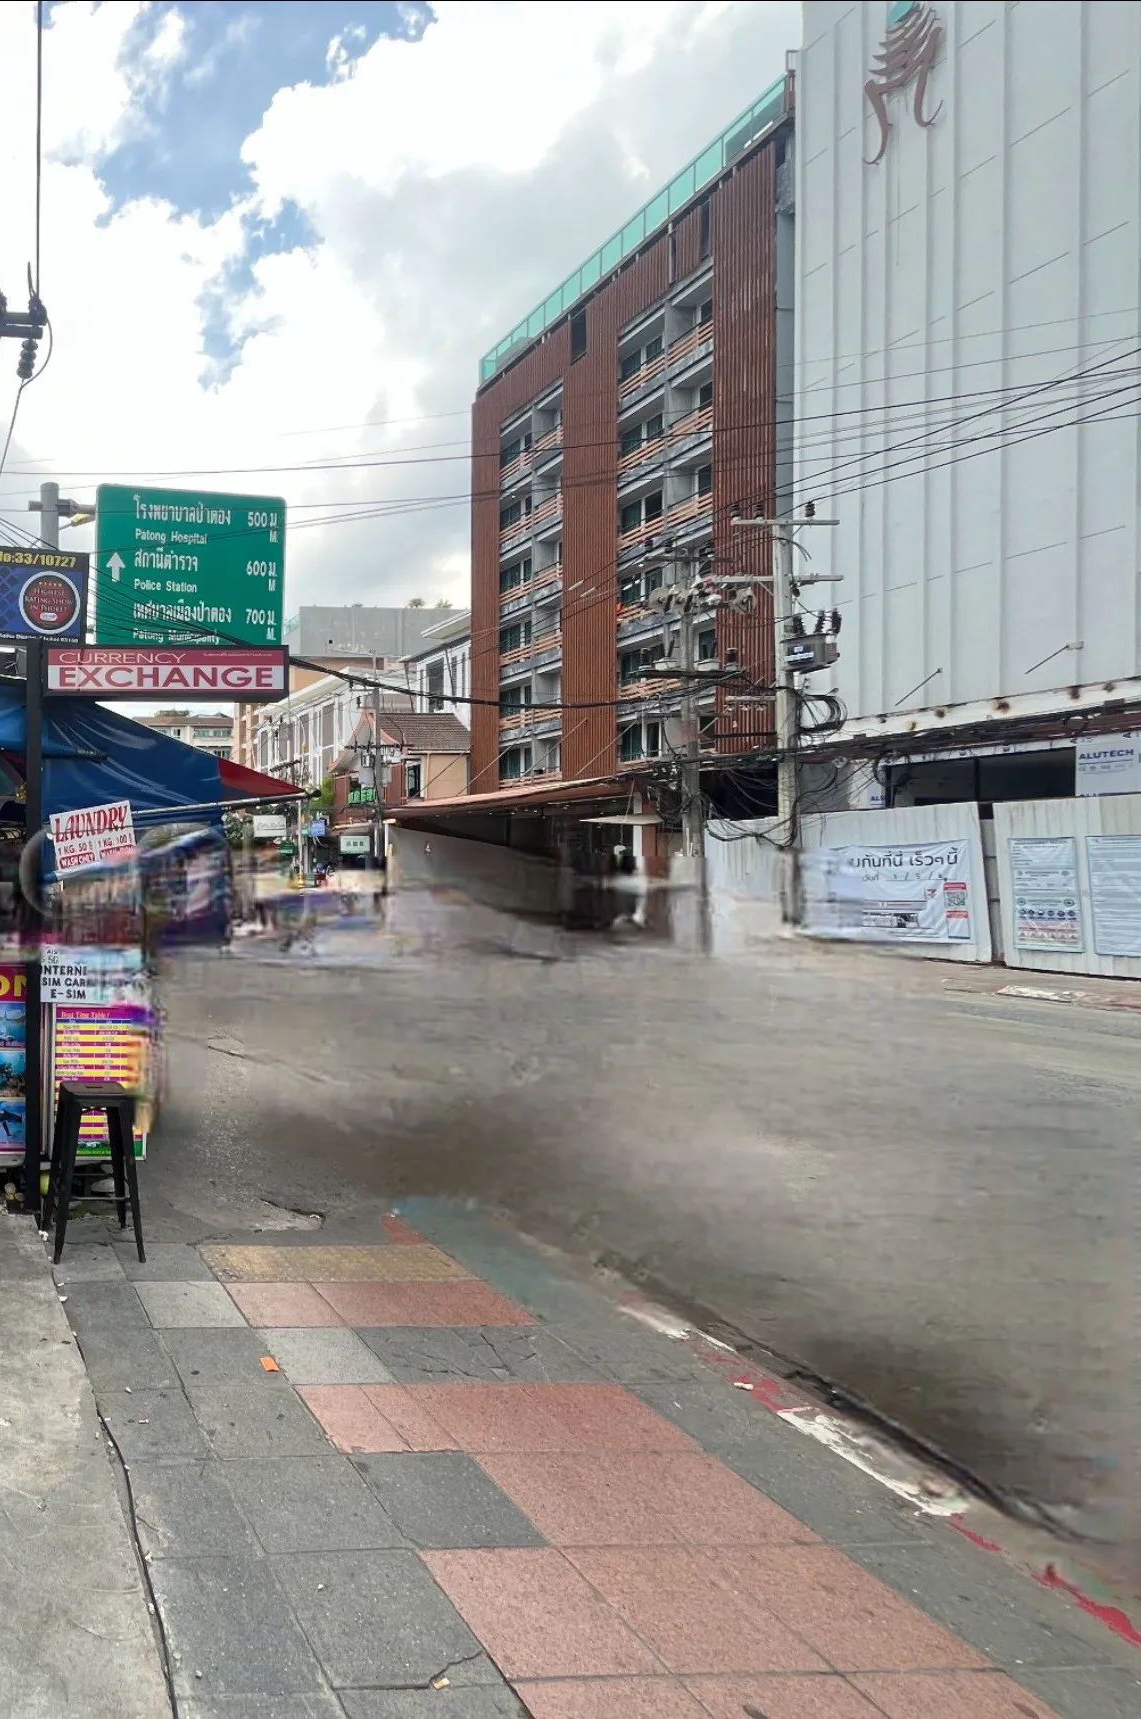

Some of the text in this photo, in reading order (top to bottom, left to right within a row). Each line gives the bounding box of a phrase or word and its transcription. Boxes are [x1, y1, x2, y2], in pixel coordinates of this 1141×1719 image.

[133, 495, 231, 525] โรงพยาบาลป่าตอง
[247, 512, 268, 528] 500
[135, 528, 166, 543] Patong
[171, 530, 207, 545] Hospital
[134, 546, 198, 572] สถานีตำรวจ
[246, 561, 267, 577] 600
[134, 579, 161, 591] Police
[166, 580, 197, 593] Station
[246, 609, 266, 625] 700
[133, 628, 164, 643] Patong
[60, 652, 186, 664] CURRENCY
[60, 666, 273, 688] EXCHANGE
[1079, 749, 1134, 760] ALUTECH
[55, 805, 128, 843] LAUNDRY
[948, 847, 958, 864] นี้
[41, 977, 60, 987] SIM
